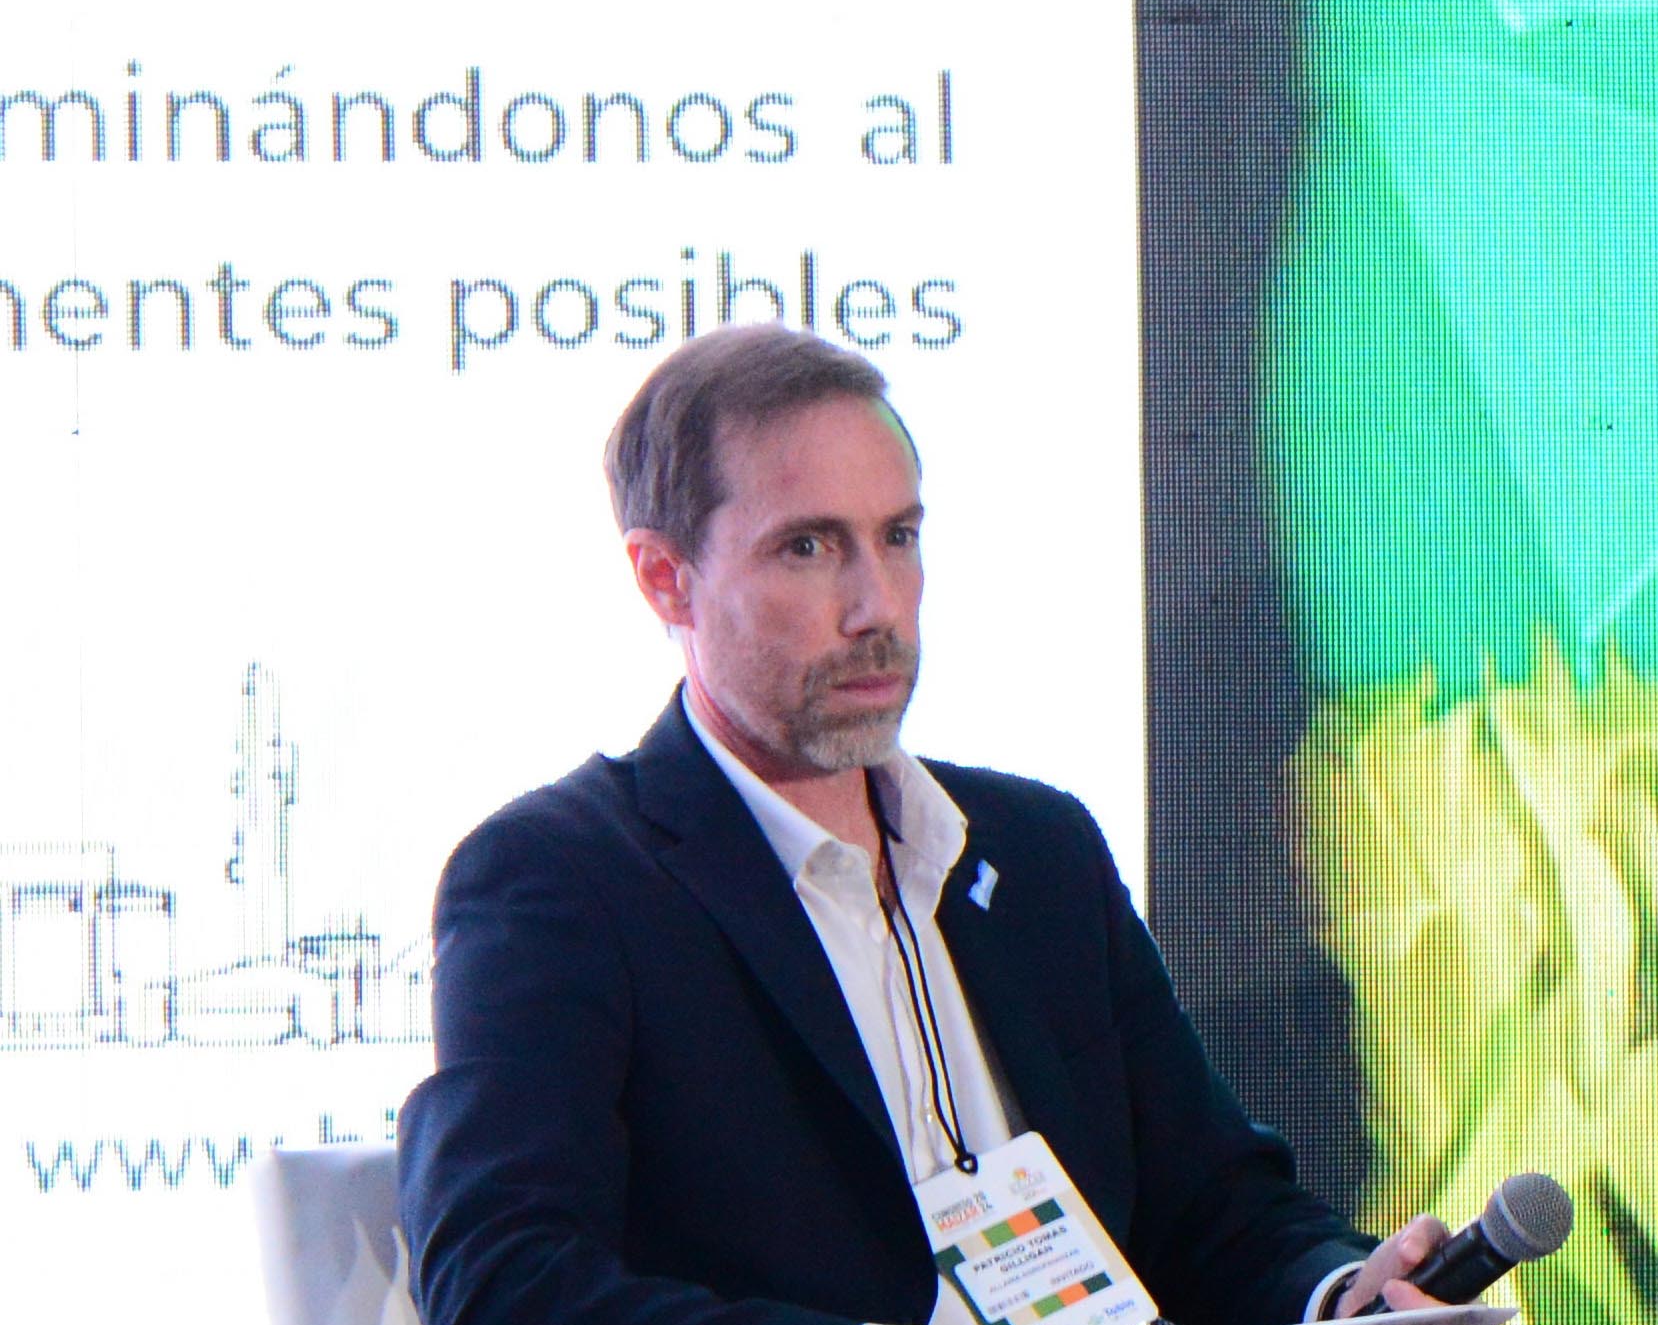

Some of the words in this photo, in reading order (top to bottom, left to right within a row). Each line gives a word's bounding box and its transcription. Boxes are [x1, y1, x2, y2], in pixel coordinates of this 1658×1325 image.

[860, 68, 954, 165] al
[449, 245, 965, 375] posibles
[973, 1244, 1025, 1273] PATRICIO
